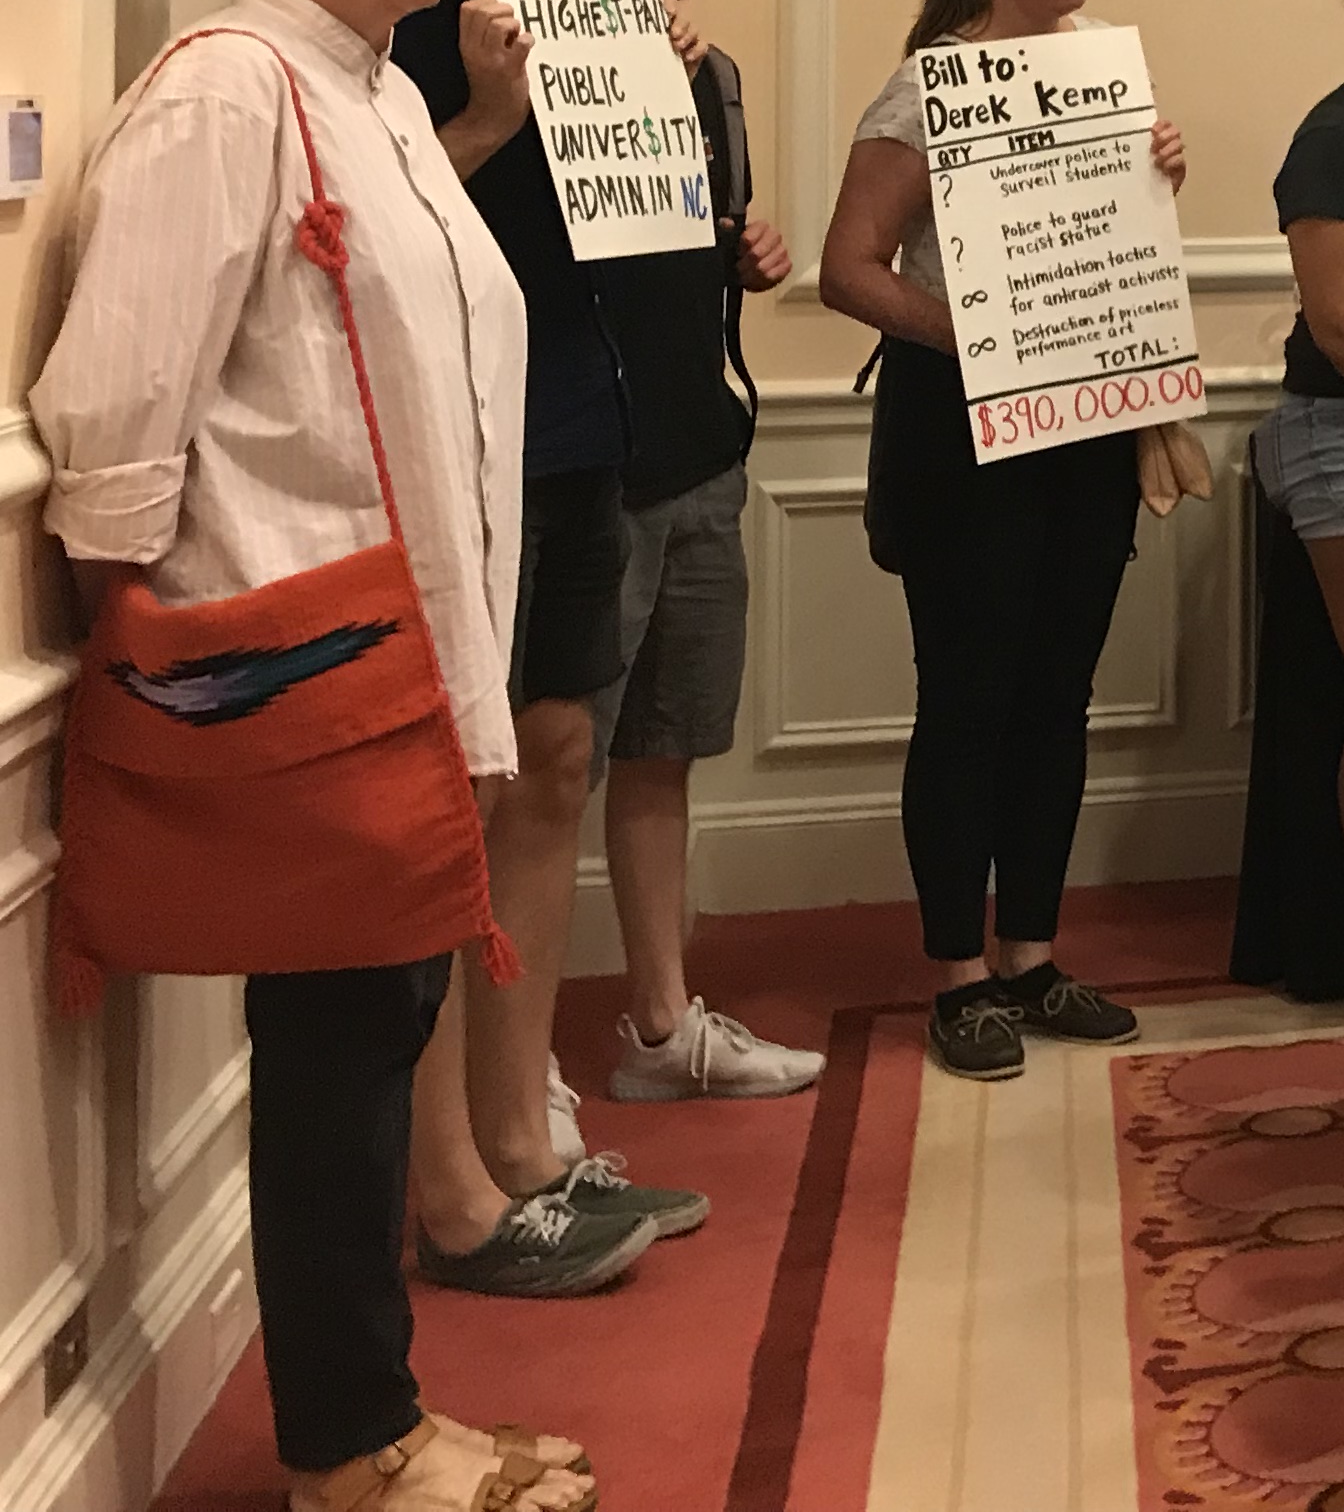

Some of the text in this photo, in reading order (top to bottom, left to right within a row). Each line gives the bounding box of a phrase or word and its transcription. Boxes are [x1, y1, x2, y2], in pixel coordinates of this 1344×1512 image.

[540, 63, 626, 111] PUBLIC
[921, 48, 1029, 91] Bill to:
[924, 95, 1012, 138] Derek
[938, 129, 1056, 168] QTY ITEM
[990, 158, 1061, 181] Undercover
[1065, 147, 1108, 171] police
[1115, 140, 1131, 154] to
[682, 172, 709, 220] NC
[1000, 169, 1056, 199] surveil
[1001, 199, 1118, 241] Police to guard
[1006, 232, 1055, 260] racist
[1007, 257, 1106, 294] Intimidation
[1108, 244, 1158, 268] tactics
[1010, 265, 1180, 316] for antiracist activists
[1012, 314, 1094, 345] Destruction
[1099, 307, 1115, 324] of
[1119, 298, 1180, 322] priceless
[1016, 320, 1135, 364] performance art
[1094, 336, 1180, 370] TOTAL:
